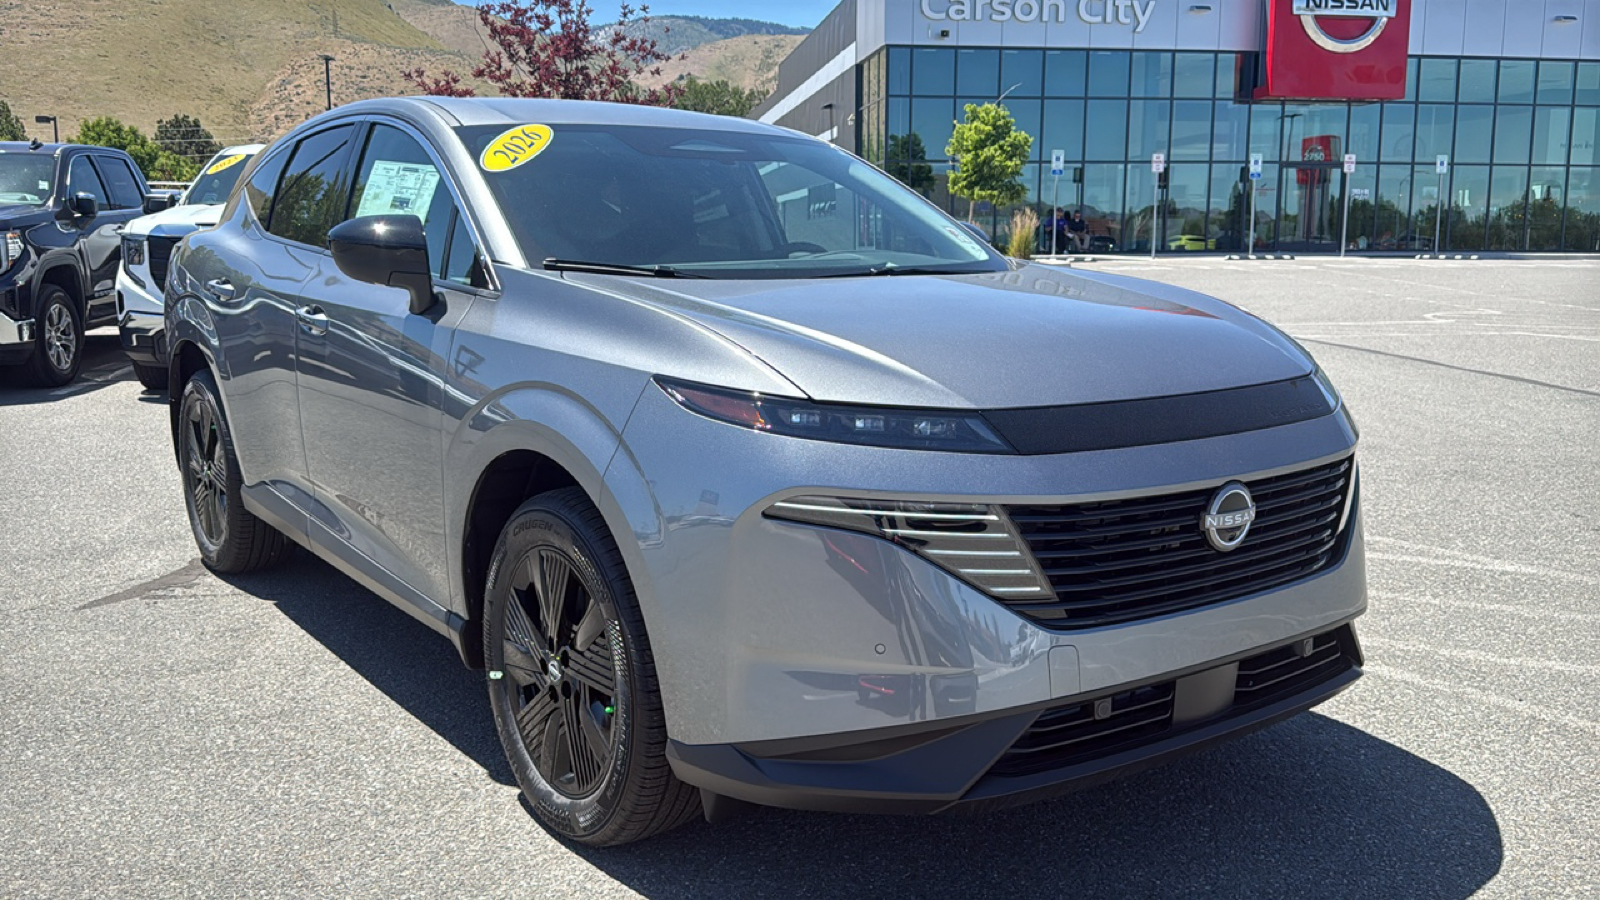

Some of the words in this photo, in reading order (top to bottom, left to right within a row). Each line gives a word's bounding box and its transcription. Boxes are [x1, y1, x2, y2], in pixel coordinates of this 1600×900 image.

[921, 0, 1066, 22] Carson
[1078, 0, 1156, 33] City
[1305, 0, 1389, 11] NISSAN
[493, 128, 542, 165] 2026
[1207, 510, 1255, 526] NISSAN
